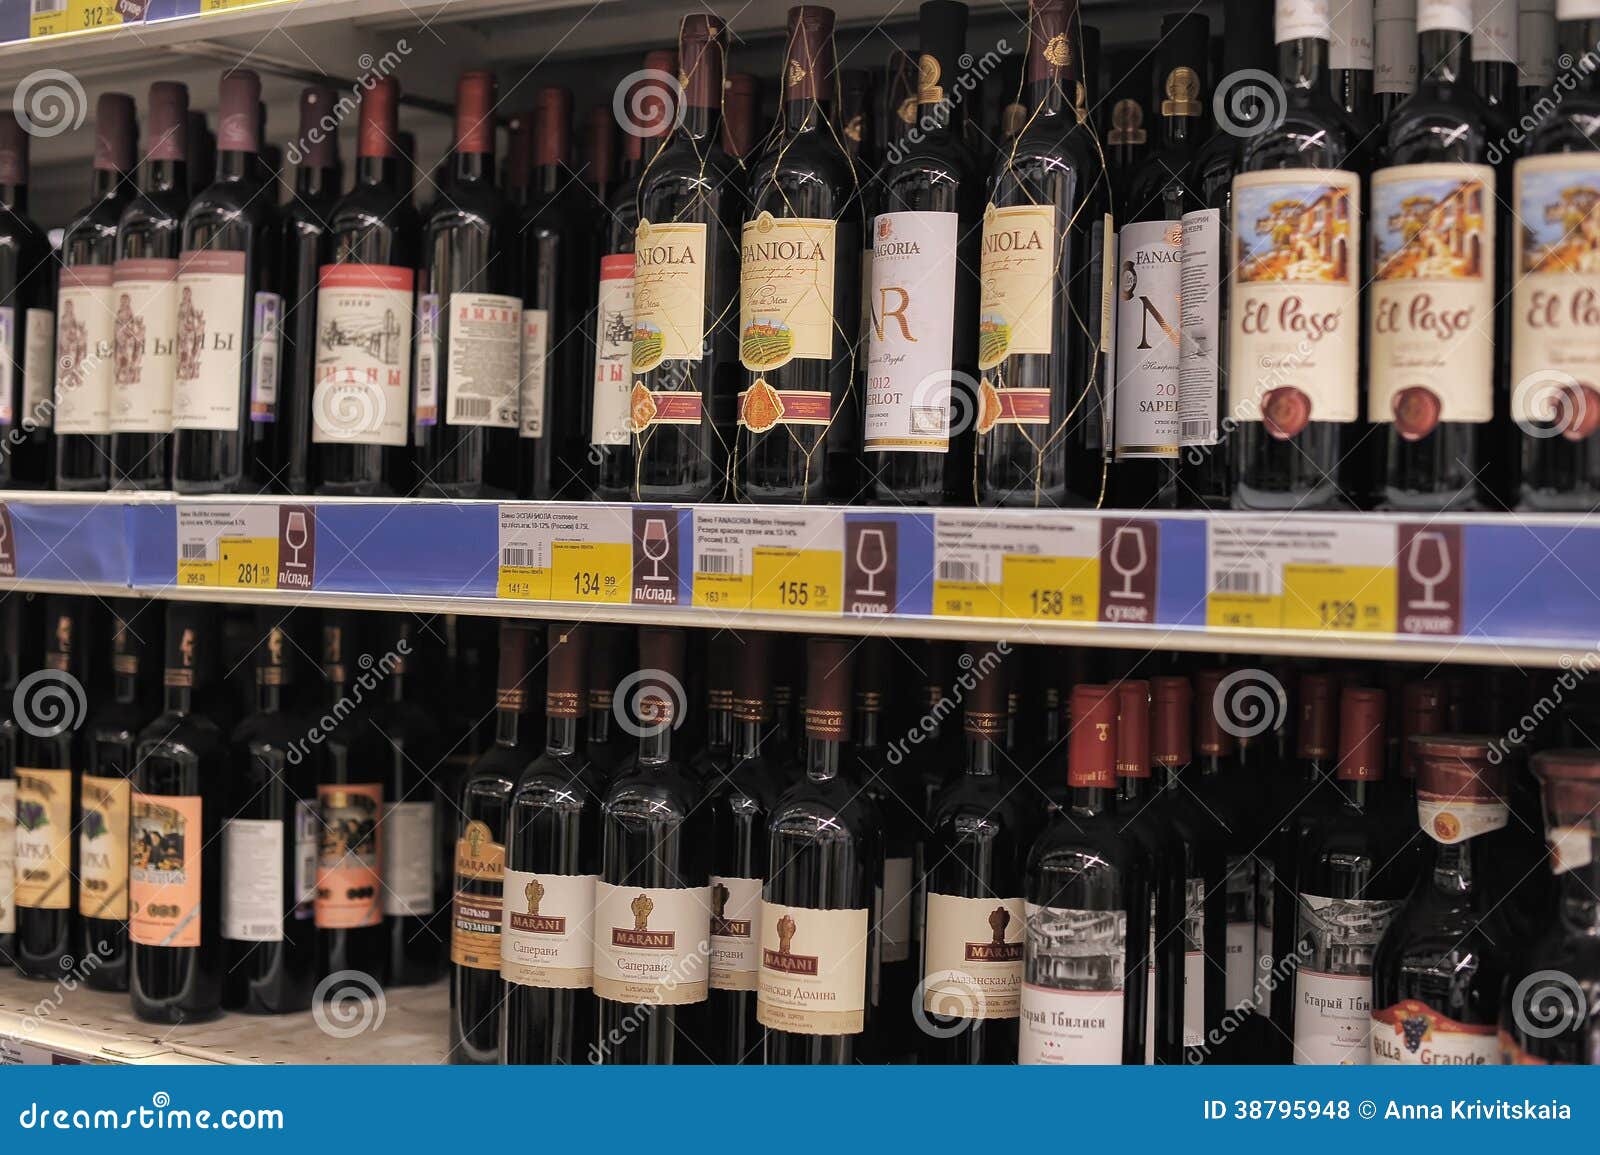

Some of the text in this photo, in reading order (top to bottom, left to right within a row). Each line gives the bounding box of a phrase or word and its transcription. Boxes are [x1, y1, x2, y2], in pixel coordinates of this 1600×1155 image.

[84, 7, 103, 27] 312
[1242, 298, 1269, 335] El
[1375, 297, 1401, 335] El
[1526, 289, 1560, 329] El
[238, 563, 258, 584] 281
[279, 570, 312, 587] п/слад.
[574, 572, 616, 595] 134 99
[635, 585, 676, 604] п/слад.
[779, 582, 808, 605] 155
[1030, 589, 1064, 615] 158
[512, 914, 560, 931] MARANI
[616, 933, 669, 946] MARANI
[513, 942, 558, 957] Саперави
[617, 958, 668, 975] Саперави
[765, 953, 812, 971] MARANI
[793, 987, 836, 1001] Долина
[1304, 992, 1343, 1014] Старый
[1051, 1012, 1106, 1028] Тбилиси
[1420, 1049, 1486, 1065] Grande
